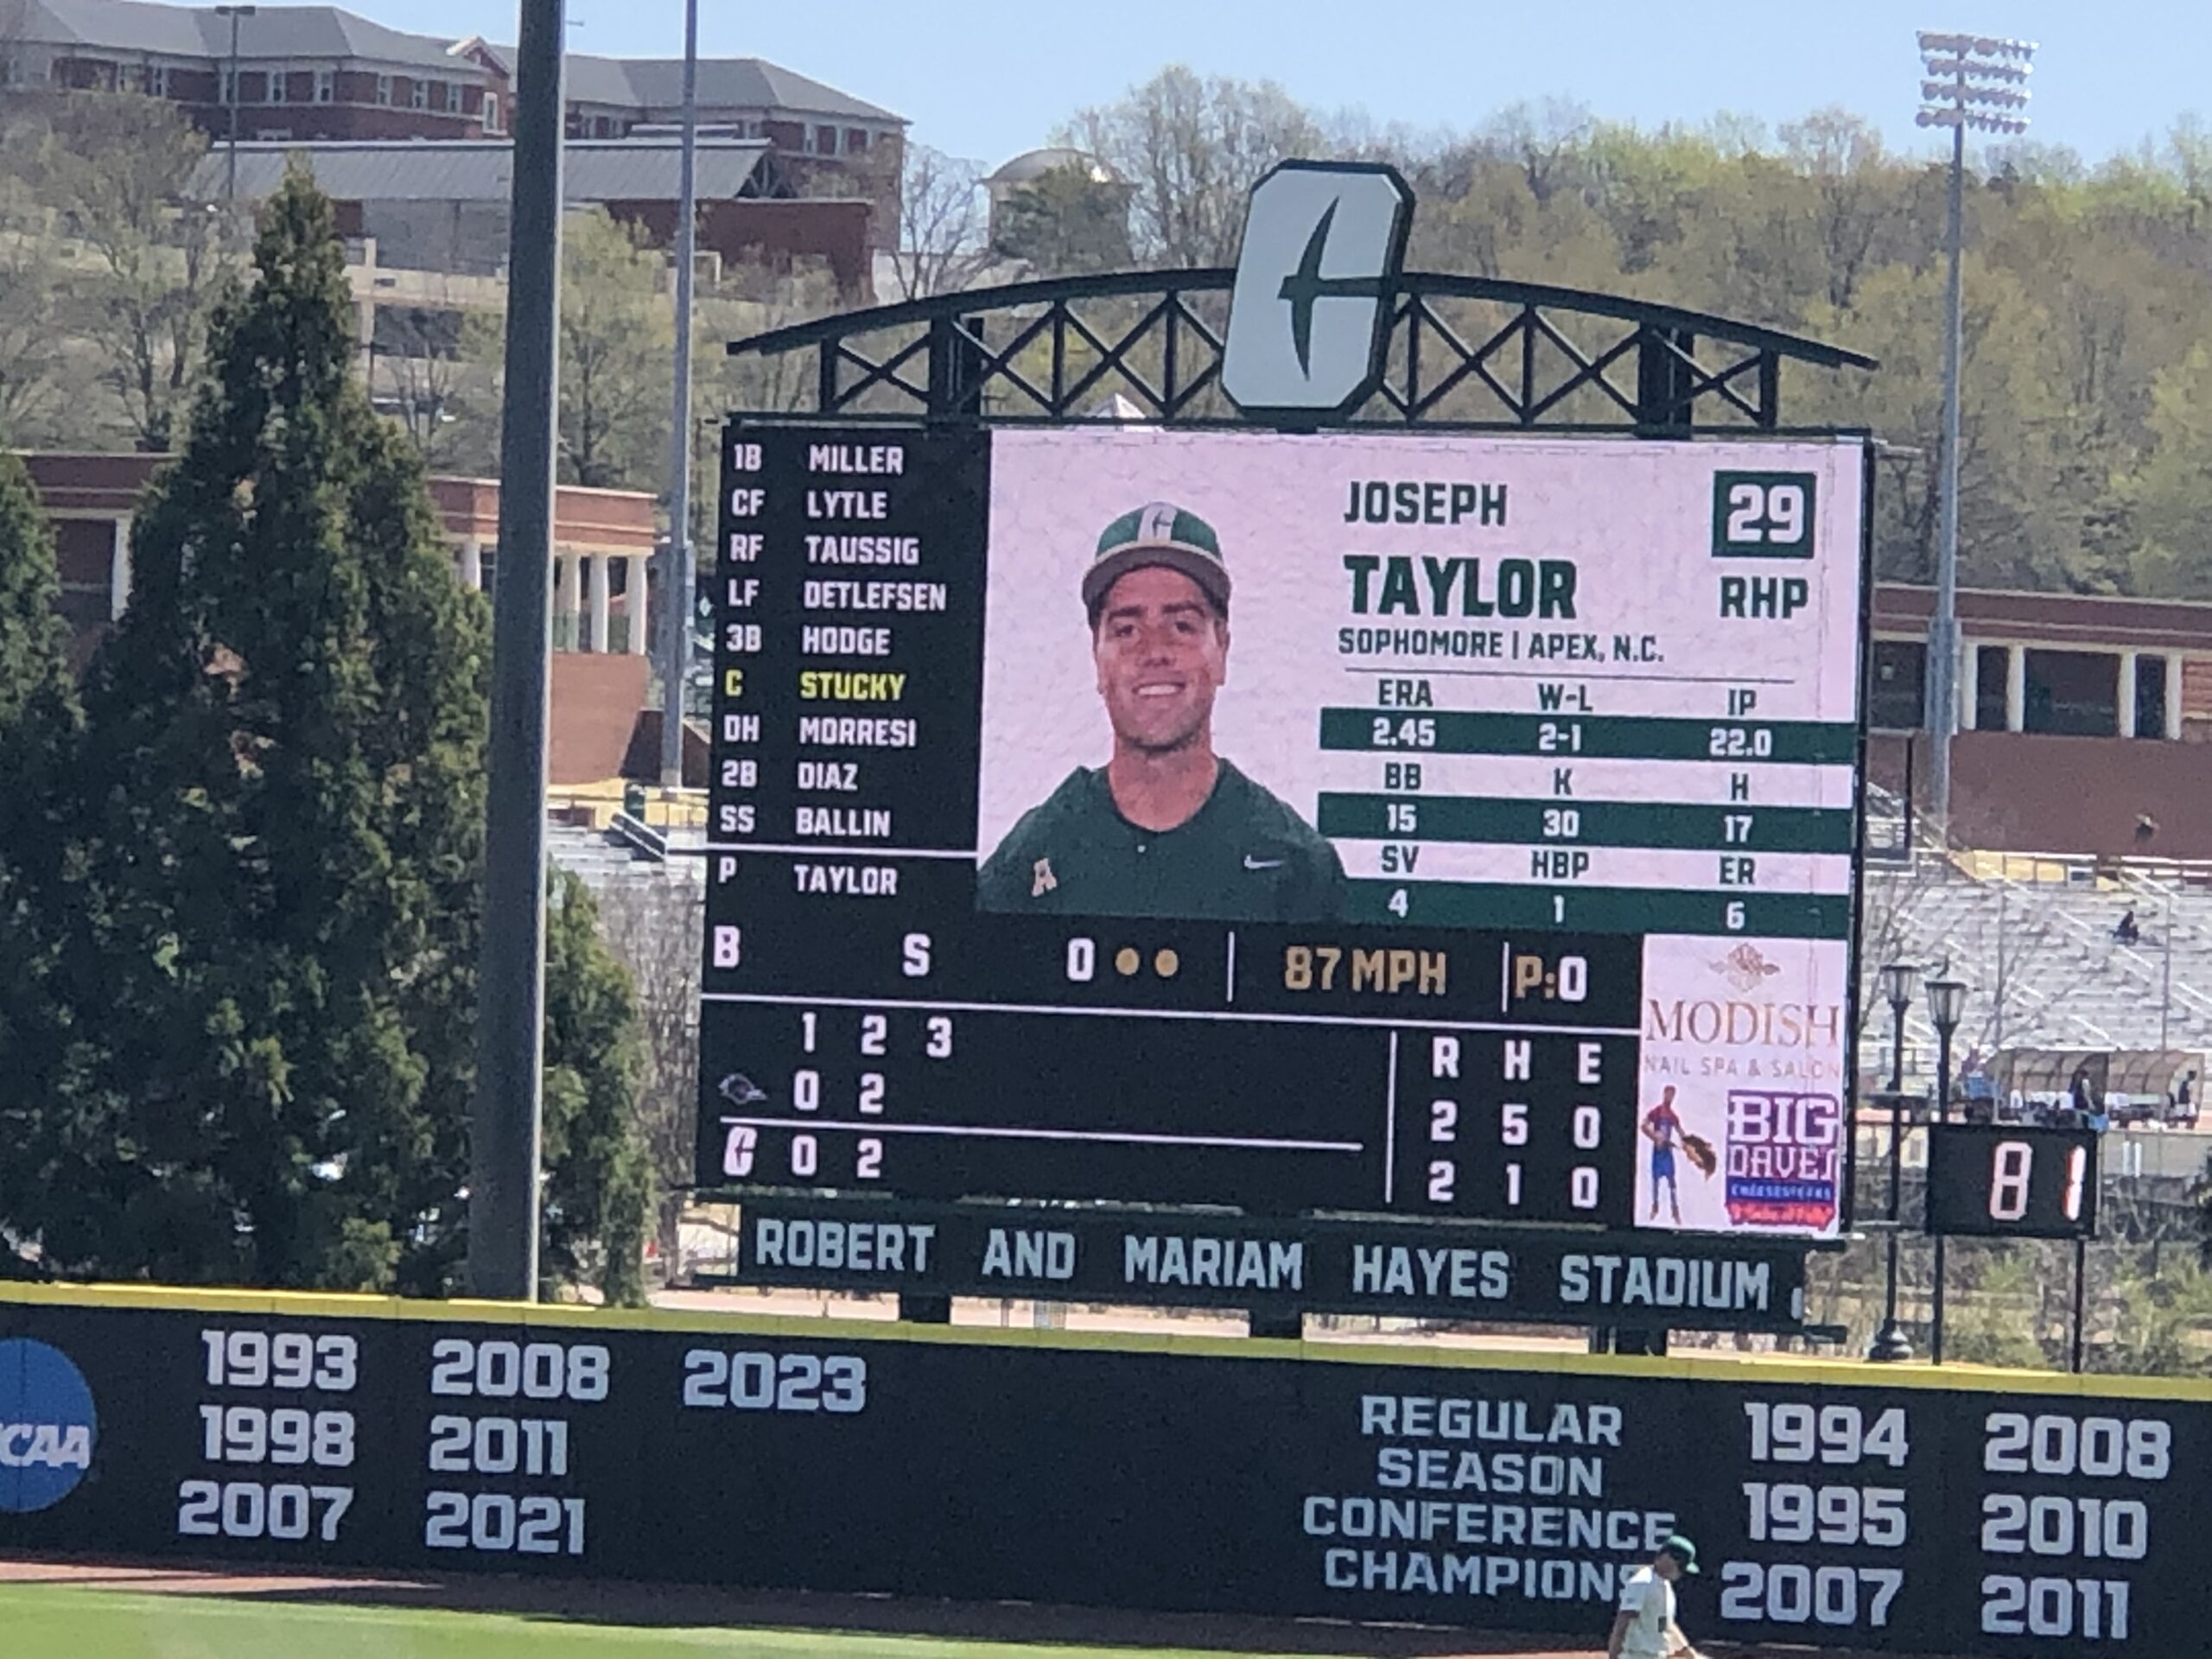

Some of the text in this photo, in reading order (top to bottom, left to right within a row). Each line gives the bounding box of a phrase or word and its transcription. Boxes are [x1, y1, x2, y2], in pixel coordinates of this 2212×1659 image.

[734, 443, 904, 475] 1B MILLER
[732, 488, 887, 518] CF LYTLE
[1344, 481, 1507, 527] JOSEPH
[1728, 483, 1804, 544] 29
[730, 533, 919, 565] RF TAUSSIG
[728, 579, 946, 611] LF DETLEFSEN
[1343, 554, 1577, 620] TAYLOR
[1719, 575, 1809, 619] RHP
[726, 623, 891, 655] 3B HODGE
[1338, 628, 1503, 658] SOPHOMORE
[1528, 632, 1605, 664] APEX,
[1612, 634, 1664, 662] N.C.
[726, 670, 906, 701] C STUCKY
[1377, 679, 1757, 715] ERA W-L IP
[724, 715, 917, 747] DH MORRESI
[1372, 719, 1772, 757] 2.45 2-1 22.0
[721, 760, 858, 791] 2B DIAZ
[1384, 762, 1750, 801] BB K H
[720, 804, 891, 837] SS BALLIN
[1386, 804, 1754, 843] 15 30 17
[718, 856, 898, 895] P TAYLOR
[1380, 846, 1756, 886] SV HBP ER
[1387, 889, 1745, 931] 4 1 6
[713, 925, 741, 969] B
[903, 933, 931, 977] S
[1285, 945, 1447, 995] 87 MPH
[1645, 999, 1840, 1049] MODISH
[802, 1012, 1603, 1084] 1 2 3 R H E
[1643, 1055, 1840, 1078] NAIL SPA & SALON
[794, 1070, 1601, 1149] 0 2 2 5 0
[1728, 1096, 1839, 1145] BIG
[791, 1135, 817, 1176] 0
[856, 1138, 883, 1179] 2
[1427, 1160, 1455, 1202] 2
[1504, 1163, 1521, 1205] 1
[1571, 1166, 1599, 1208] 0
[755, 1217, 1770, 1311] ROBERT AND MARIAM HAYES STADIUM
[201, 1329, 867, 1413] 1993 2008 2023
[199, 1404, 568, 1476] 1998 2011
[1361, 1395, 1623, 1447] REGULAR
[1744, 1402, 2171, 1479] 1994 2008
[0, 1422, 90, 1469] CAA
[1377, 1447, 1603, 1498] SEASON
[178, 1479, 585, 1555] 2007 2021
[1303, 1496, 1676, 1552] CONFERENCE
[1742, 1482, 2148, 1560] 1995 2010
[1720, 1560, 2130, 1640] 2007 2011
